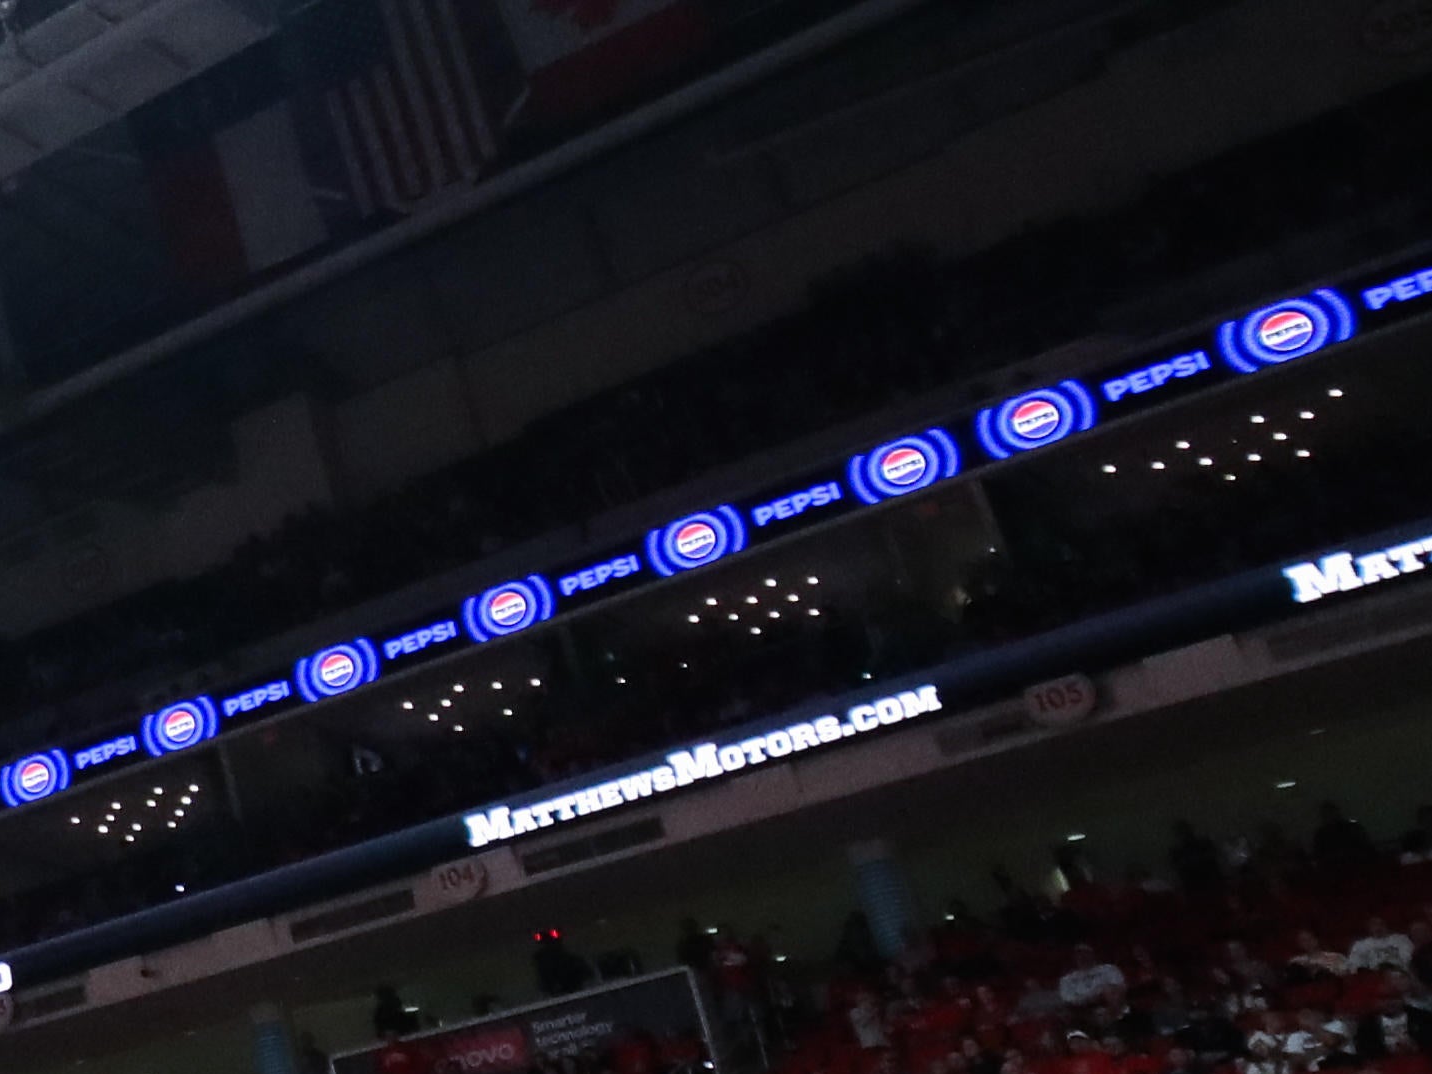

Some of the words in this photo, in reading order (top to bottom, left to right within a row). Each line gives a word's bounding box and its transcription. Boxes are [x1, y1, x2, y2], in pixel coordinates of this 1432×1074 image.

[1101, 350, 1212, 402] PEPSI
[751, 481, 843, 526] PEPSI
[558, 554, 641, 596] PEPSI
[383, 620, 457, 660] PEPSI
[223, 681, 291, 716] PEPSI
[1034, 682, 1082, 711] 105
[75, 735, 137, 769] PEPSI
[438, 864, 474, 890] 104
